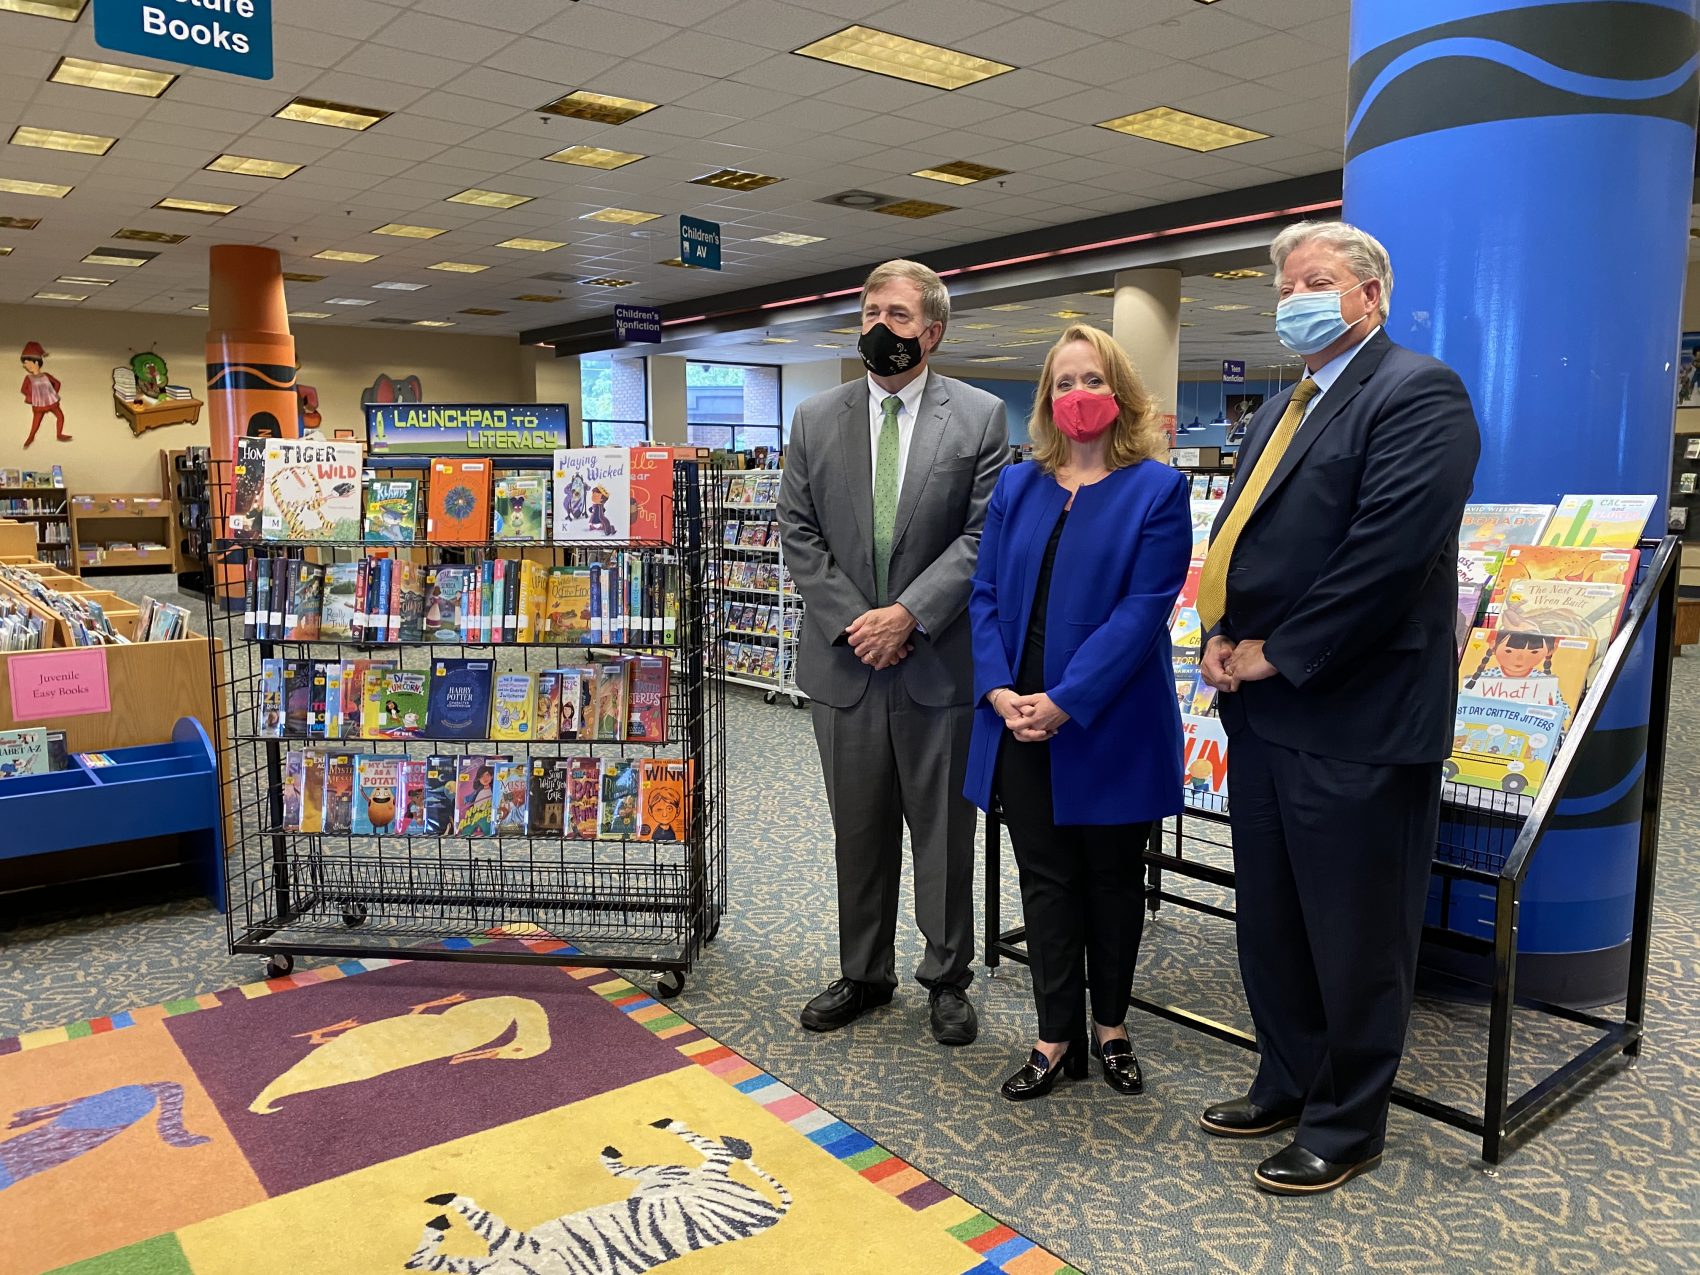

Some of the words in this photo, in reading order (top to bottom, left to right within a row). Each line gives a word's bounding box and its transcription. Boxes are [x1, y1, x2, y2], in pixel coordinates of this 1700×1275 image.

[143, 5, 250, 54] Books
[682, 224, 720, 245] Children's
[696, 246, 708, 258] AV
[616, 308, 659, 320] Children's
[616, 319, 660, 332] Nonfiction
[1223, 374, 1244, 382] Nonfiction
[394, 409, 507, 428] LAUNCHPAD
[512, 416, 538, 428] TO
[466, 430, 559, 449] LITERACY
[243, 446, 266, 460] HOM
[280, 445, 337, 464] TIGER
[560, 455, 598, 470] Playing
[317, 464, 357, 480] WILD
[586, 464, 624, 481] Wicked
[271, 519, 280, 527] M
[561, 523, 568, 532] K
[1528, 585, 1546, 595] The
[1549, 585, 1571, 595] Nest
[1533, 597, 1561, 605] Wren
[1562, 597, 1591, 608] Built
[38, 671, 80, 685] Juvenile
[33, 689, 56, 699] Easy
[59, 685, 89, 696] Books
[391, 683, 420, 693] UNICORN
[449, 686, 473, 694] HARRY
[1482, 681, 1530, 698] What
[446, 693, 473, 702] POTTER
[628, 692, 661, 706] STERIES
[1469, 706, 1485, 715] DAY
[1486, 707, 1521, 721] CRITTER
[1520, 714, 1555, 732] JITTERS
[1183, 723, 1198, 735] HE
[364, 777, 398, 786] POTAT
